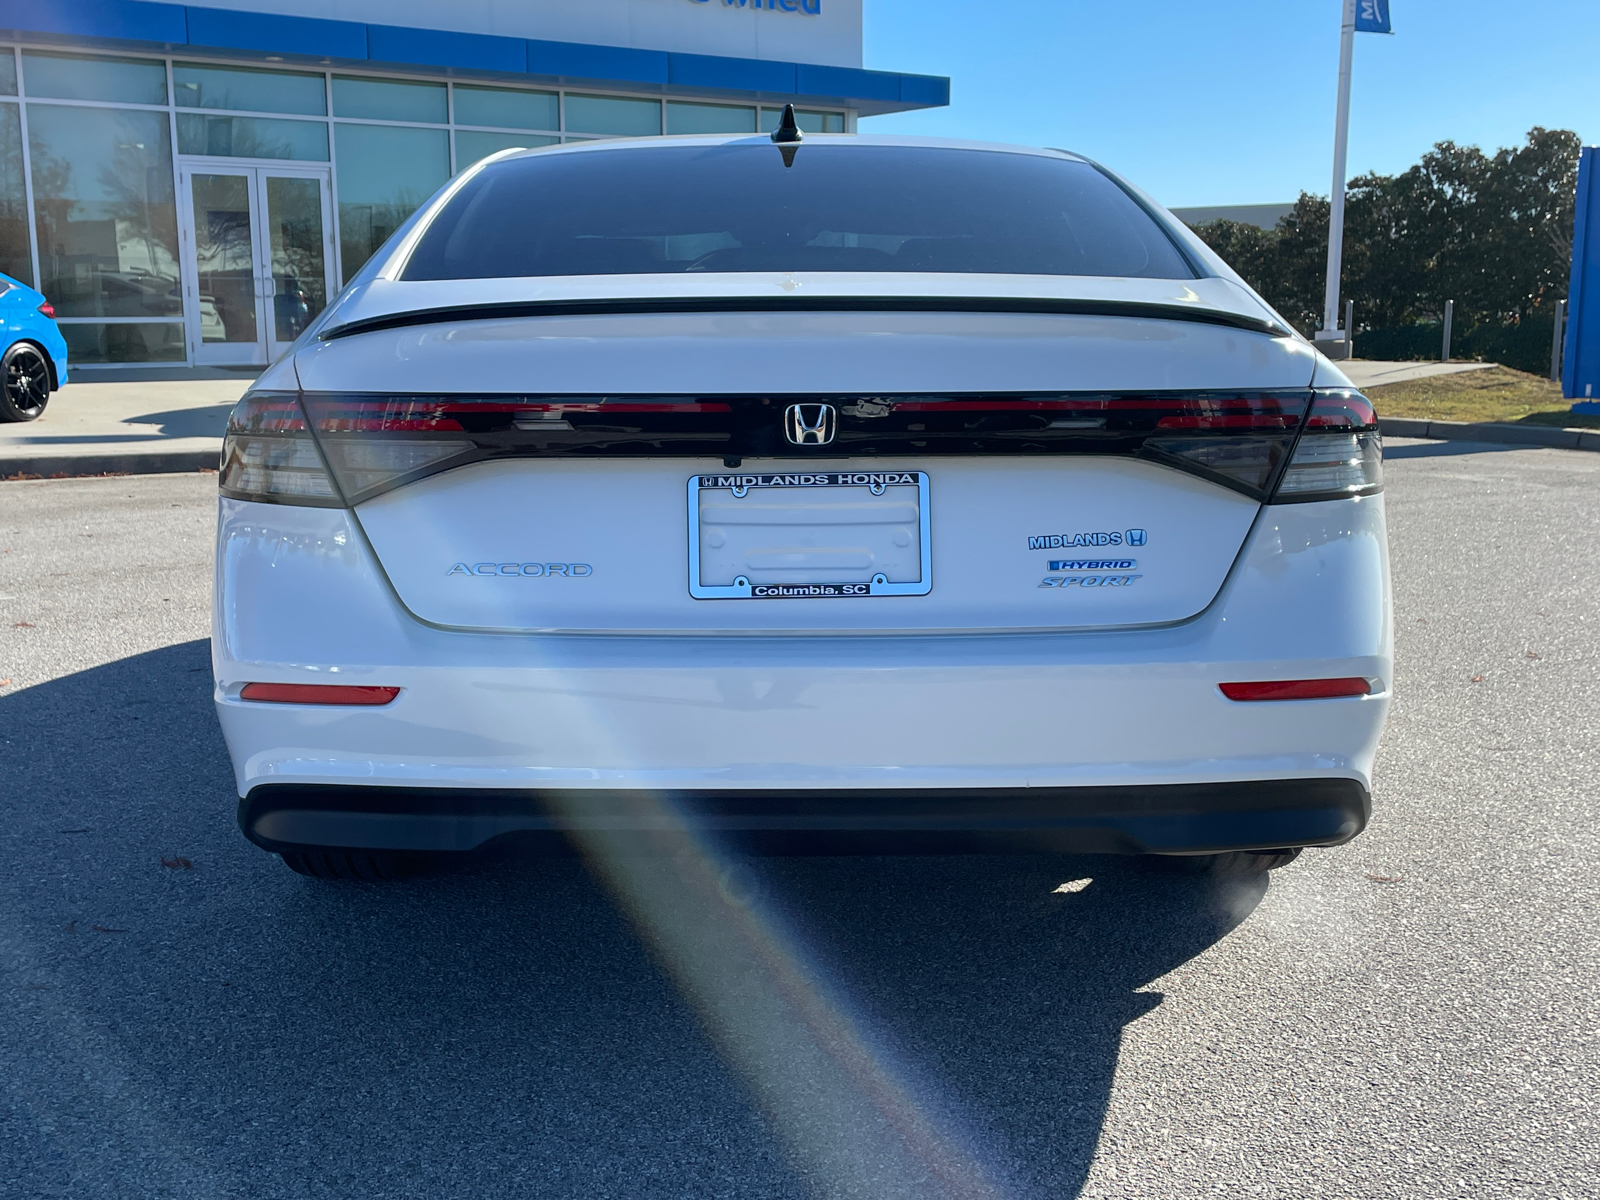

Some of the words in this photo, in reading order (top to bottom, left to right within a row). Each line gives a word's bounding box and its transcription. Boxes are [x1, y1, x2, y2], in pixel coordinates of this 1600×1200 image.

[718, 475, 829, 486] MIDLANDS
[837, 474, 915, 484] HONDA
[1028, 532, 1122, 550] MIDLANDS
[446, 562, 593, 577] ACCORD
[1061, 561, 1132, 570] HYBRID
[1037, 575, 1143, 588] SPORT
[755, 586, 839, 595] Columbia,
[842, 585, 867, 594] SC
